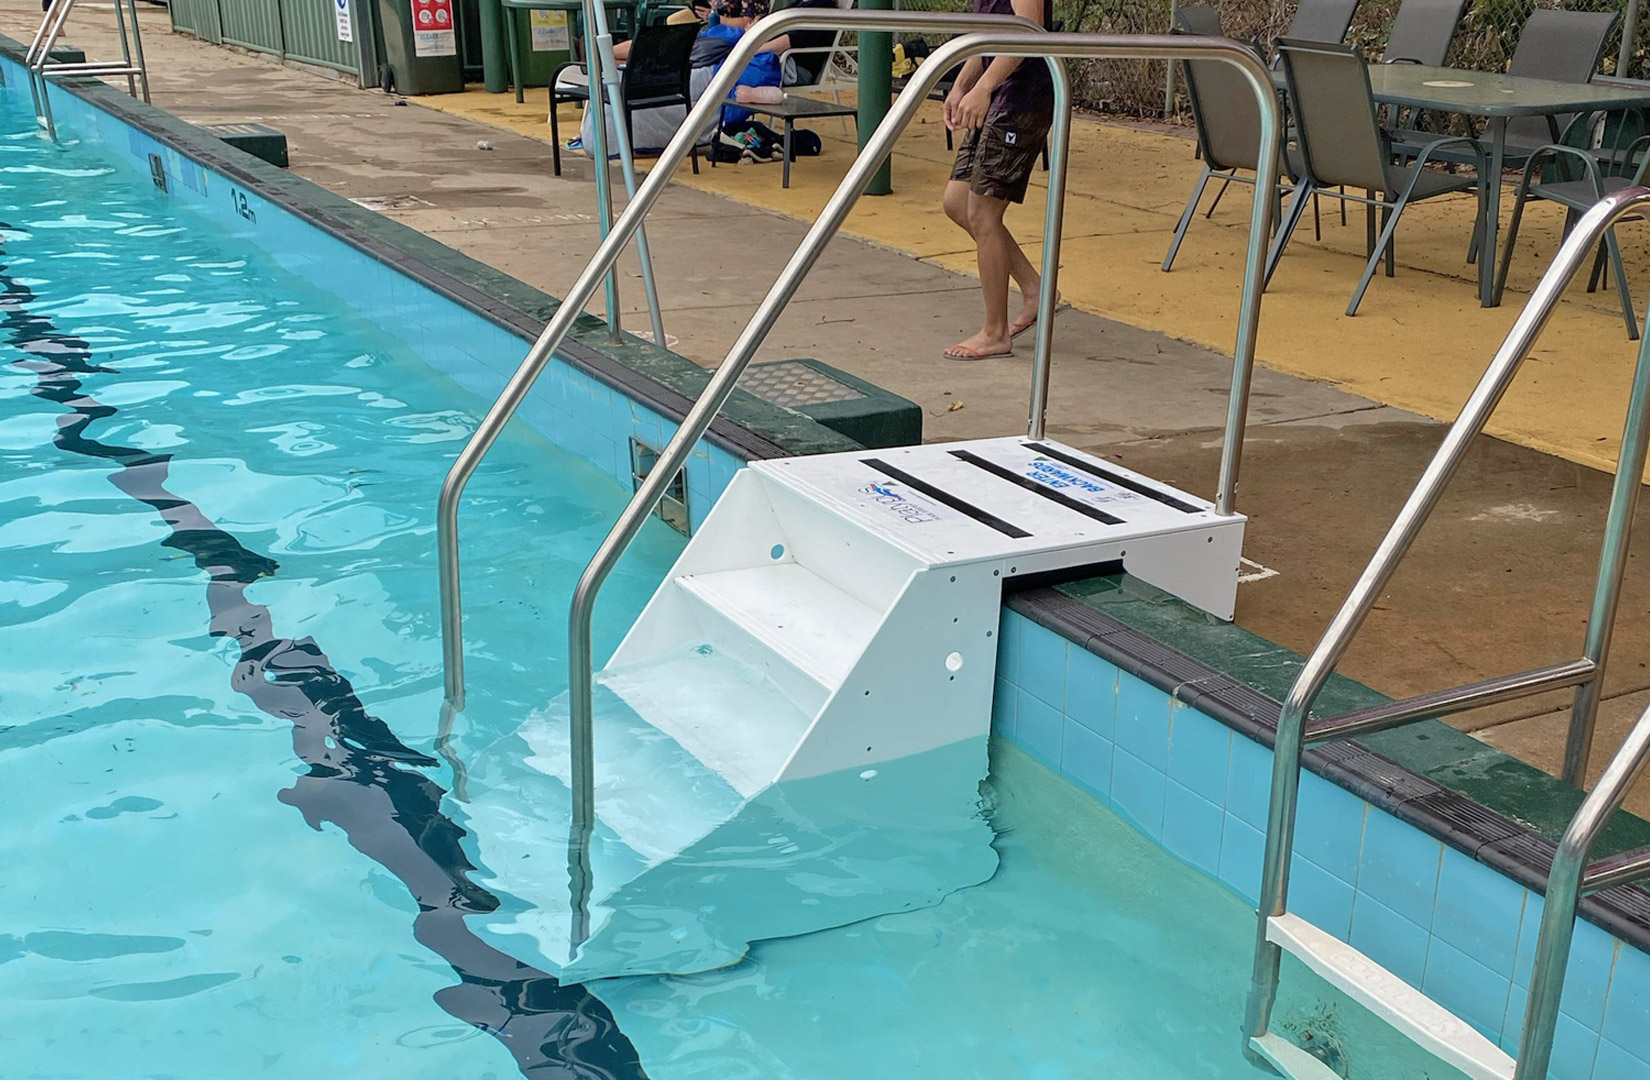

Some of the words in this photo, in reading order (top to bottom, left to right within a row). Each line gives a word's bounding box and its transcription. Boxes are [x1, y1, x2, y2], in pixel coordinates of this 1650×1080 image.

[231, 188, 257, 225] 1.2m
[1026, 471, 1071, 489] ENTER
[1028, 462, 1105, 493] BACKWARDS
